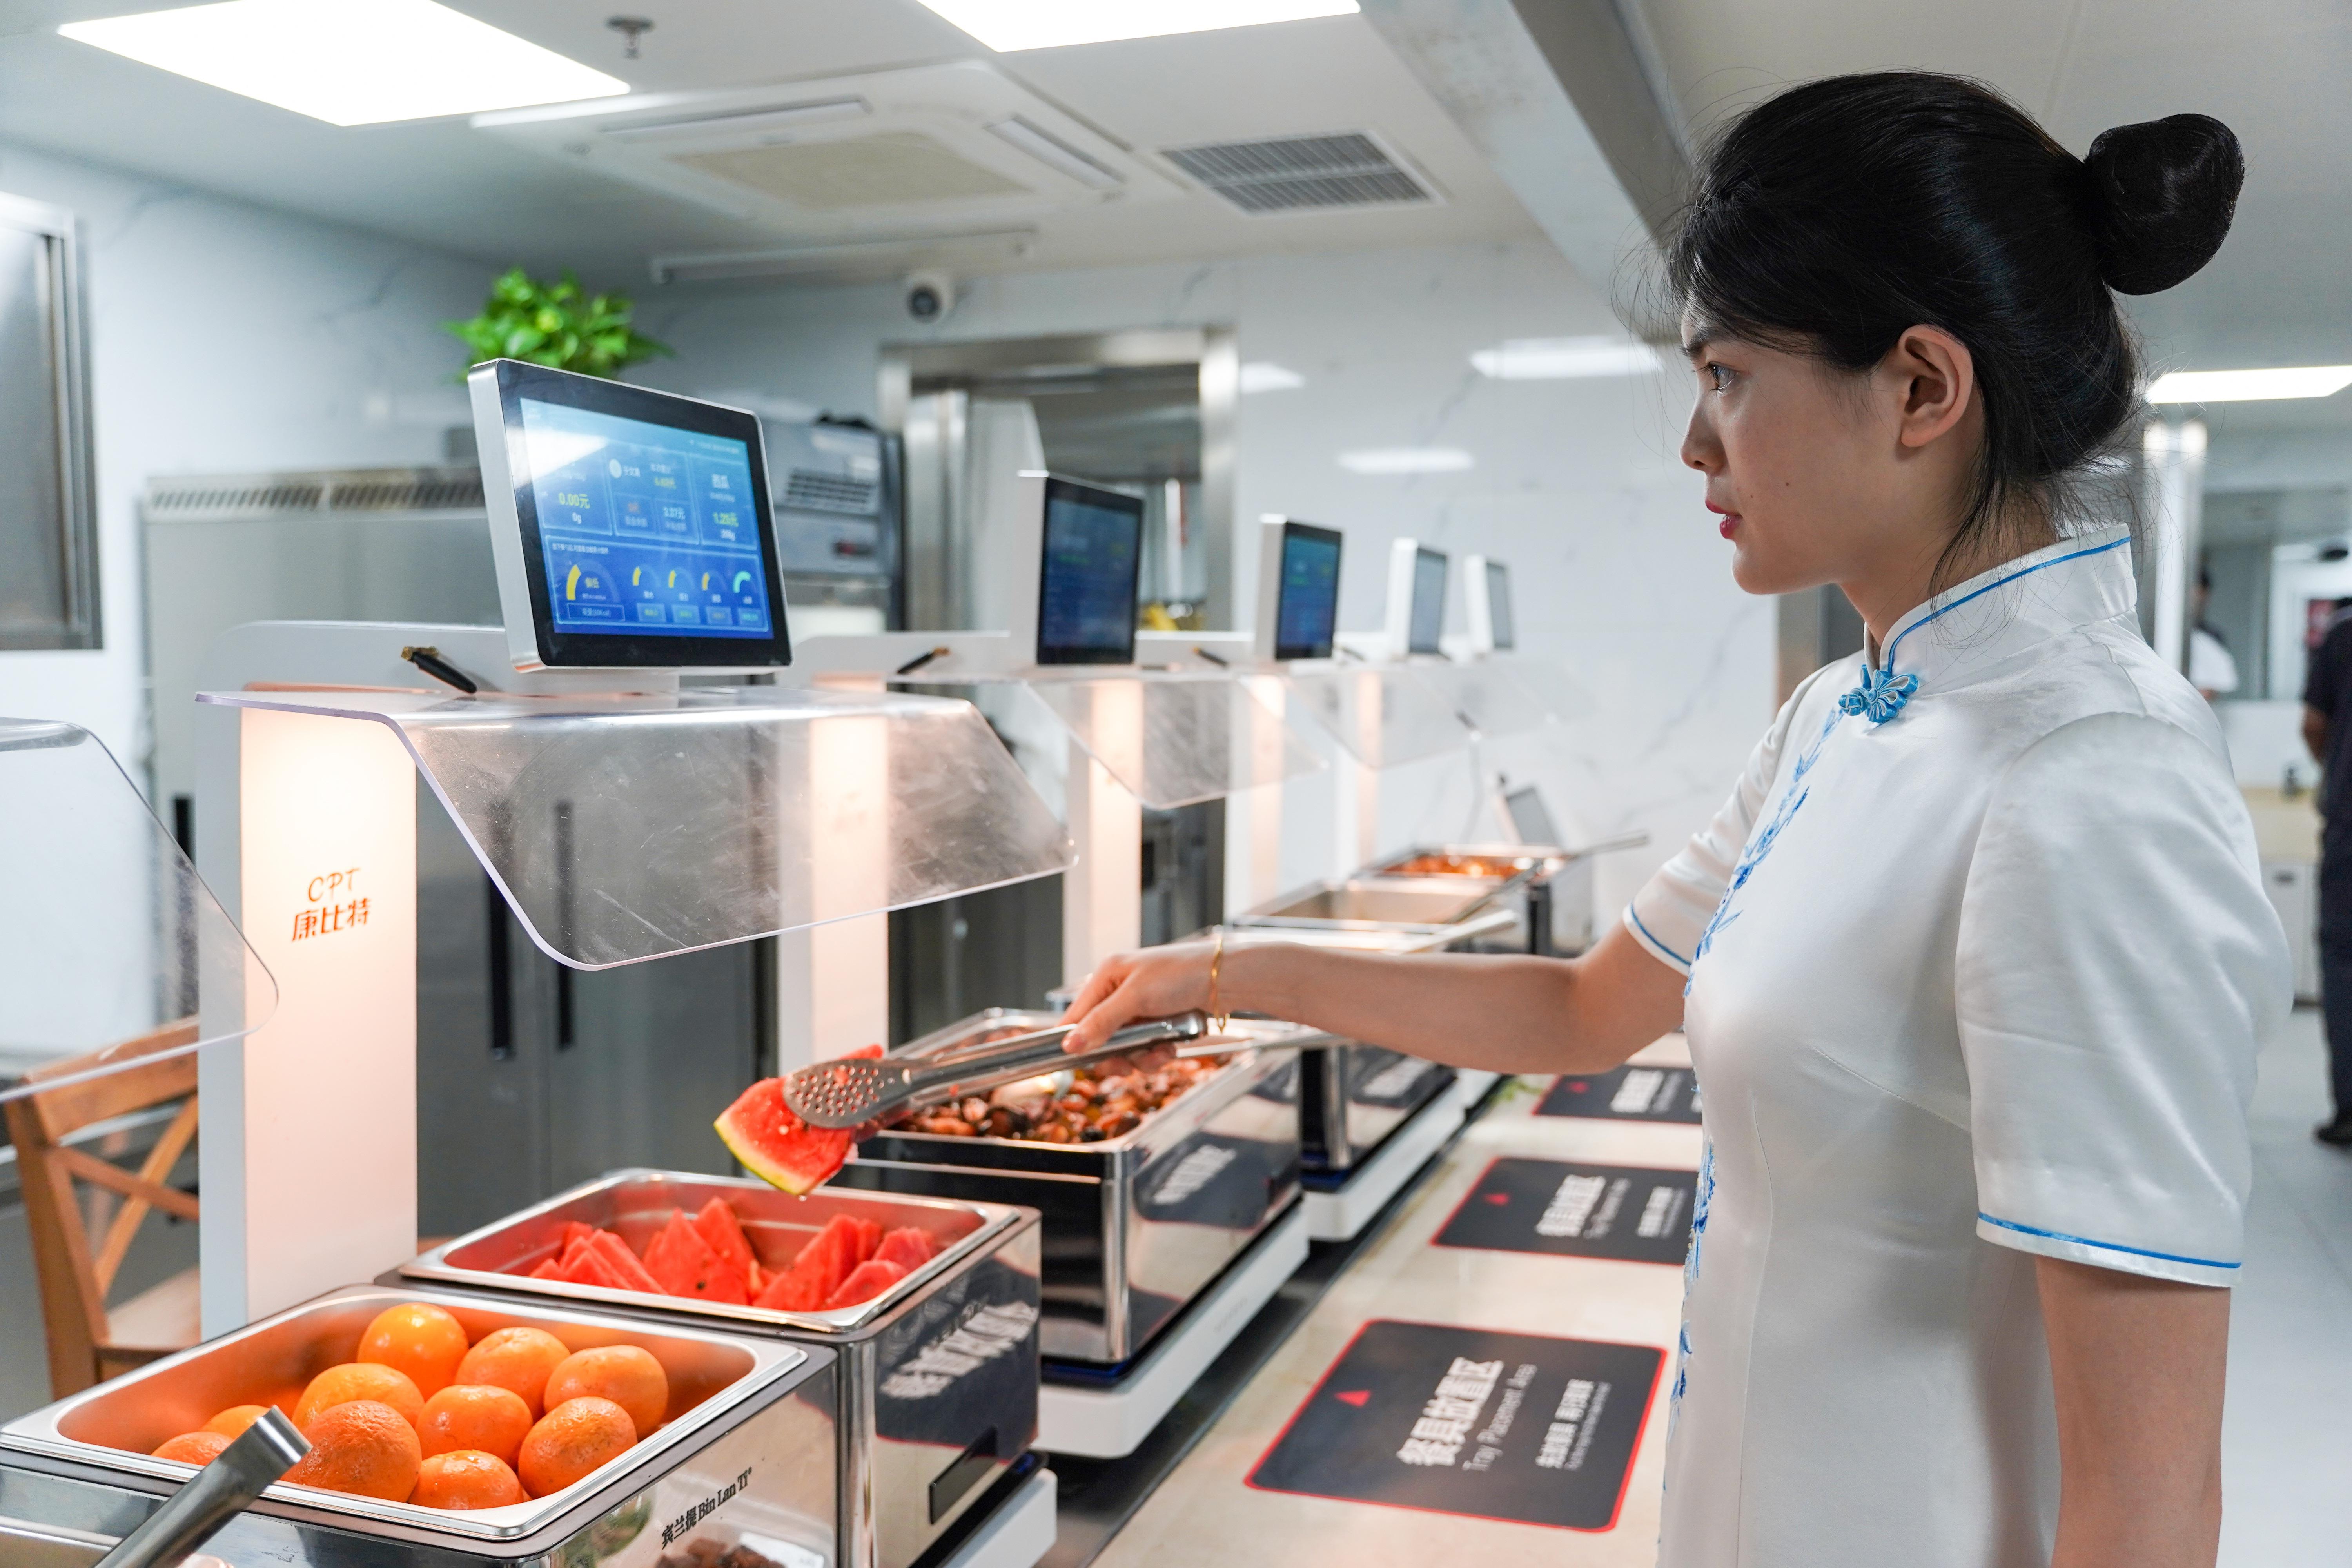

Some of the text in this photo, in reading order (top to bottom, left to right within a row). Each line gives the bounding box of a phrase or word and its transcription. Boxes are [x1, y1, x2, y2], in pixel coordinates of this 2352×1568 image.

[558, 492, 590, 509] 0.00元
[572, 512, 582, 524] 0g
[308, 867, 361, 902] CPT
[292, 898, 371, 941] 康比特
[698, 1498, 715, 1521] Bin
[717, 1483, 736, 1507] Lan
